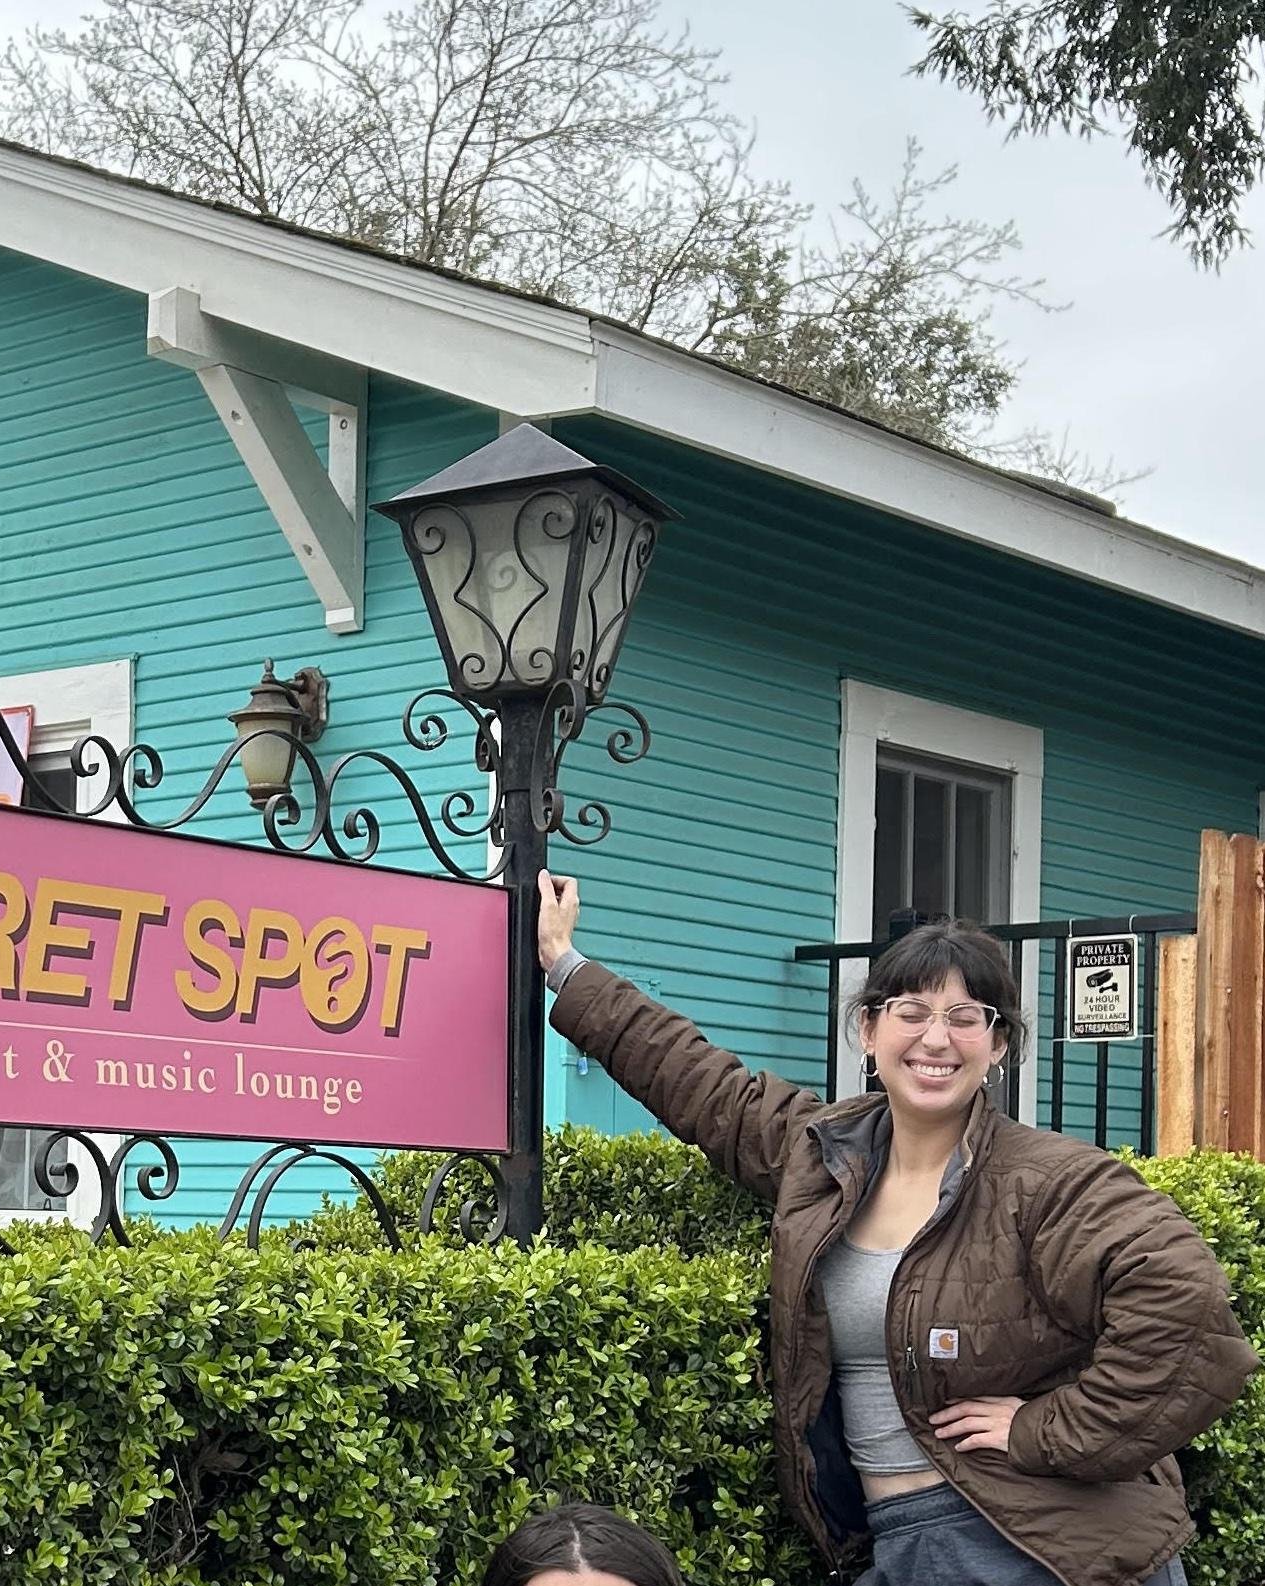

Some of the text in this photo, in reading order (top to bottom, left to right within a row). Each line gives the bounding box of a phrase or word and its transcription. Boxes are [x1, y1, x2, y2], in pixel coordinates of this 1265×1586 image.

[1081, 944, 1124, 955] PRIVATE
[1076, 953, 1130, 966] PROPERTY
[174, 899, 432, 1039] SPOT
[1095, 994, 1120, 1003] HOUR
[1089, 1004, 1115, 1012] VIDEO
[1077, 1012, 1127, 1021] SURVEILLANCE
[42, 1039, 75, 1083] &
[95, 1049, 217, 1094] music
[234, 1052, 363, 1115] lounge
